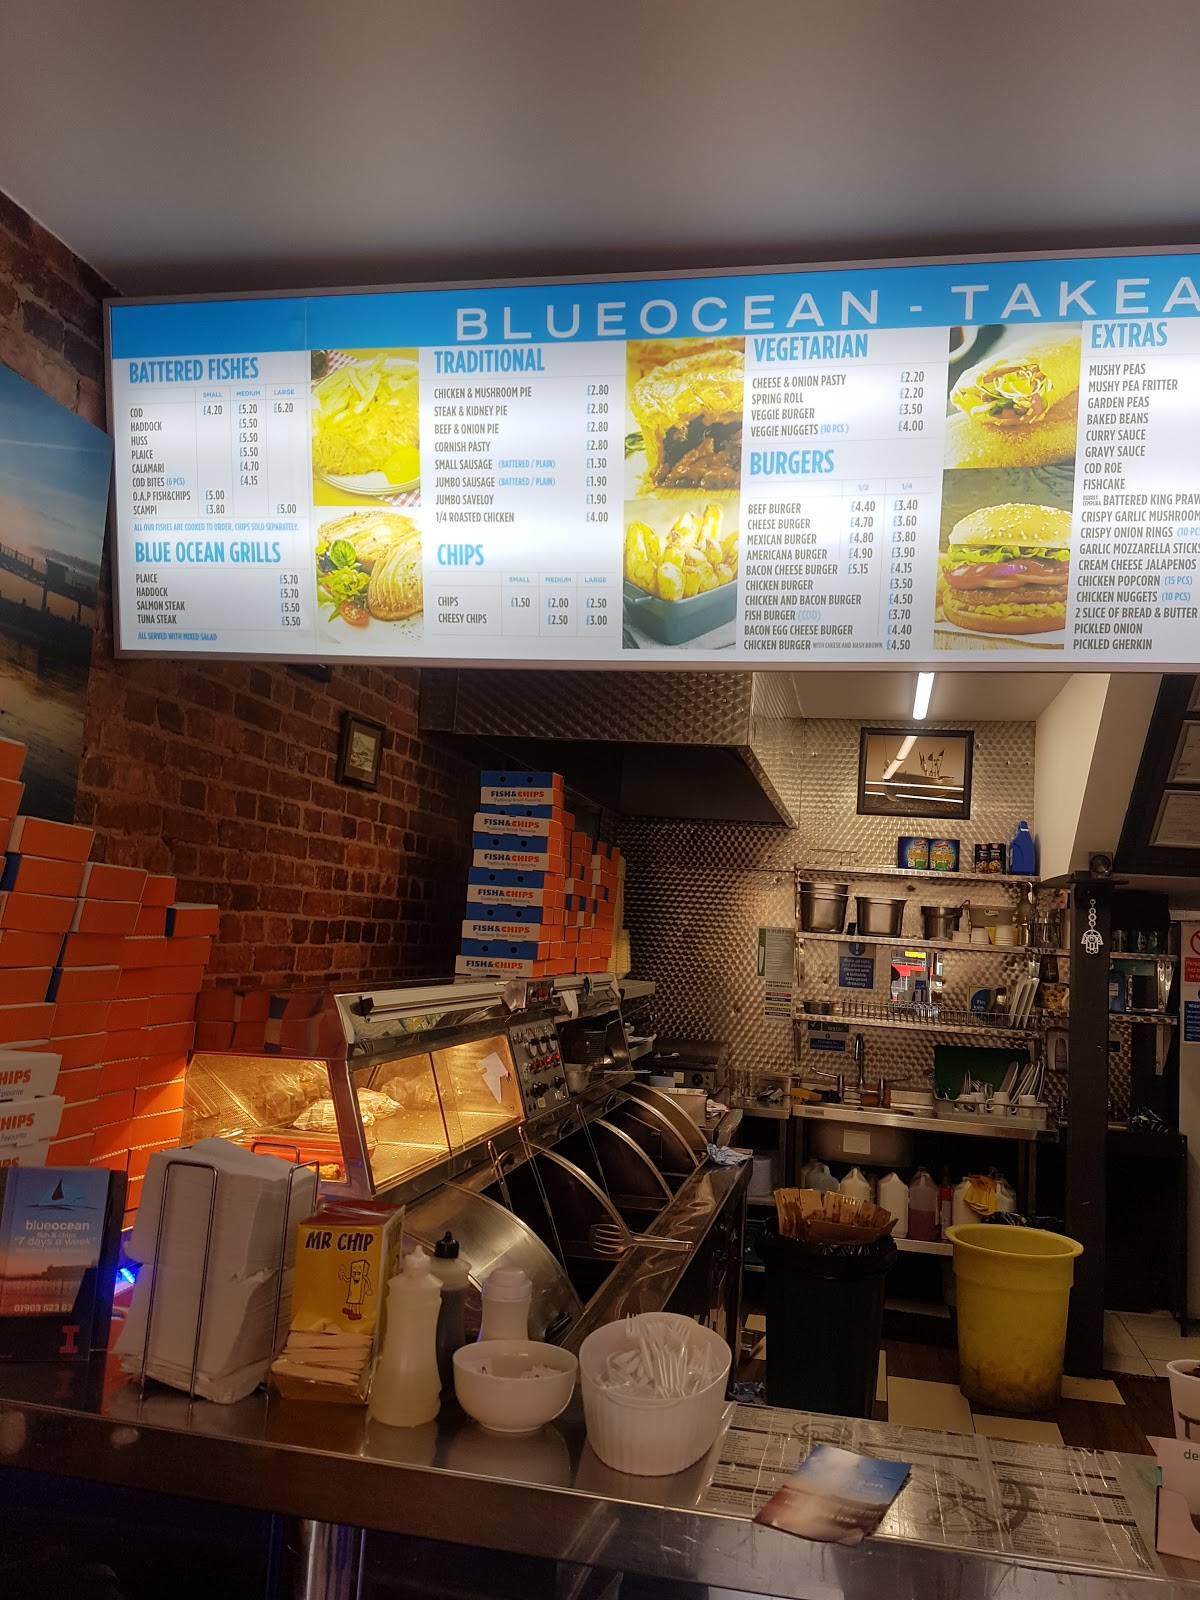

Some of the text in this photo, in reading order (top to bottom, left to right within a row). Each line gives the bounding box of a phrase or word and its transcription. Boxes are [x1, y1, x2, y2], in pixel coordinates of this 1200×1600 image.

[456, 291, 878, 341] BLUEOCEAN
[952, 276, 1200, 321] TAKEA
[1091, 322, 1168, 348] EXTRAS
[754, 333, 868, 362] VEGETARIAN
[434, 348, 544, 374] TRADITIONAL
[129, 357, 259, 384] BATTERED FISHES
[1089, 363, 1146, 376] MUSHY PEAS
[753, 374, 846, 389] CHEESE & ONION PASTY
[1088, 379, 1178, 392] MUSHY PEA FRITTER
[434, 386, 532, 399] CHICKEN & MUSHROOM PIE
[752, 392, 804, 405] SPRING ROLL
[1088, 396, 1149, 409] GARDEN PEAS
[130, 407, 143, 418] COD
[434, 405, 507, 417] STEAK & KIDNEY PIE
[751, 408, 815, 421] VEGGIE BURGER
[1087, 412, 1149, 425] BAKED BEANS
[131, 421, 162, 431] HADDOCK
[435, 424, 499, 434] BEEF & ONION PIE
[751, 424, 818, 437] VEGGIE NUGGETS
[131, 436, 148, 446] HUSS
[1086, 429, 1146, 441] CURRY SAUCE
[434, 441, 491, 452] CORNISH PASTY
[1085, 445, 1145, 458] GRAVY SAUCE
[131, 450, 153, 460] PLAICE
[132, 463, 164, 473] CALAMARI
[435, 459, 492, 470] SMALL SAUSAGE
[750, 449, 834, 476] BURGERS
[1084, 462, 1122, 474] COD ROE
[132, 477, 165, 487] COD BITES
[435, 477, 495, 487] JUMBO SAUSAGE
[1083, 478, 1125, 490] FISHCAKE
[133, 490, 191, 501] O.A.P FISH&CHIPS
[436, 495, 494, 505] JUMBO SAVELOY
[1103, 495, 1147, 506] BATTERED
[1150, 494, 1173, 505] KING
[133, 505, 157, 515] SCAMPI
[748, 503, 801, 514] BEEF BURGER
[1081, 510, 1146, 522] CRISPY GARLIC
[748, 518, 810, 530] CHEESE BURGER
[1081, 526, 1173, 539] CRISPY ONION RINGS
[747, 533, 817, 545] MEXICAN BURGER
[135, 542, 281, 563] BLUE OCEAN GRILLS
[437, 544, 485, 566] CHIPS
[746, 549, 827, 561] AMERICANA BURGER
[1080, 543, 1170, 555] GARLIC MOZZARELLA
[746, 564, 838, 576] BACON CHEESE BURGER
[1079, 558, 1197, 571] CREAM CHEESE JALAPENOS
[136, 574, 157, 583] PLAICE
[1077, 575, 1115, 587] CHICKEN
[1118, 575, 1160, 587] POPCORN
[745, 579, 813, 591] CHICKEN BURGER
[137, 587, 168, 597] HADDOCK
[1076, 591, 1114, 603] CHICKEN
[1116, 591, 1158, 603] NUGGETS
[137, 601, 185, 611] SALMON STEAK
[438, 597, 458, 607] CHIPS
[745, 594, 861, 606] CHICKEN AND BACON BURGER
[137, 615, 177, 624] TUNA STEAK
[438, 613, 487, 624] CHEESY CHIPS
[744, 610, 795, 621] FISH BURGER
[744, 624, 853, 636] BACON EGG CHEESE BURGER
[1074, 623, 1143, 634] PICKLED ONION
[744, 640, 811, 650] CHICKEN BURGER
[1073, 639, 1152, 650] PICKLED GHERKIN
[26, 1220, 90, 1231] blueocean
[305, 1232, 374, 1252] MR CHIP
